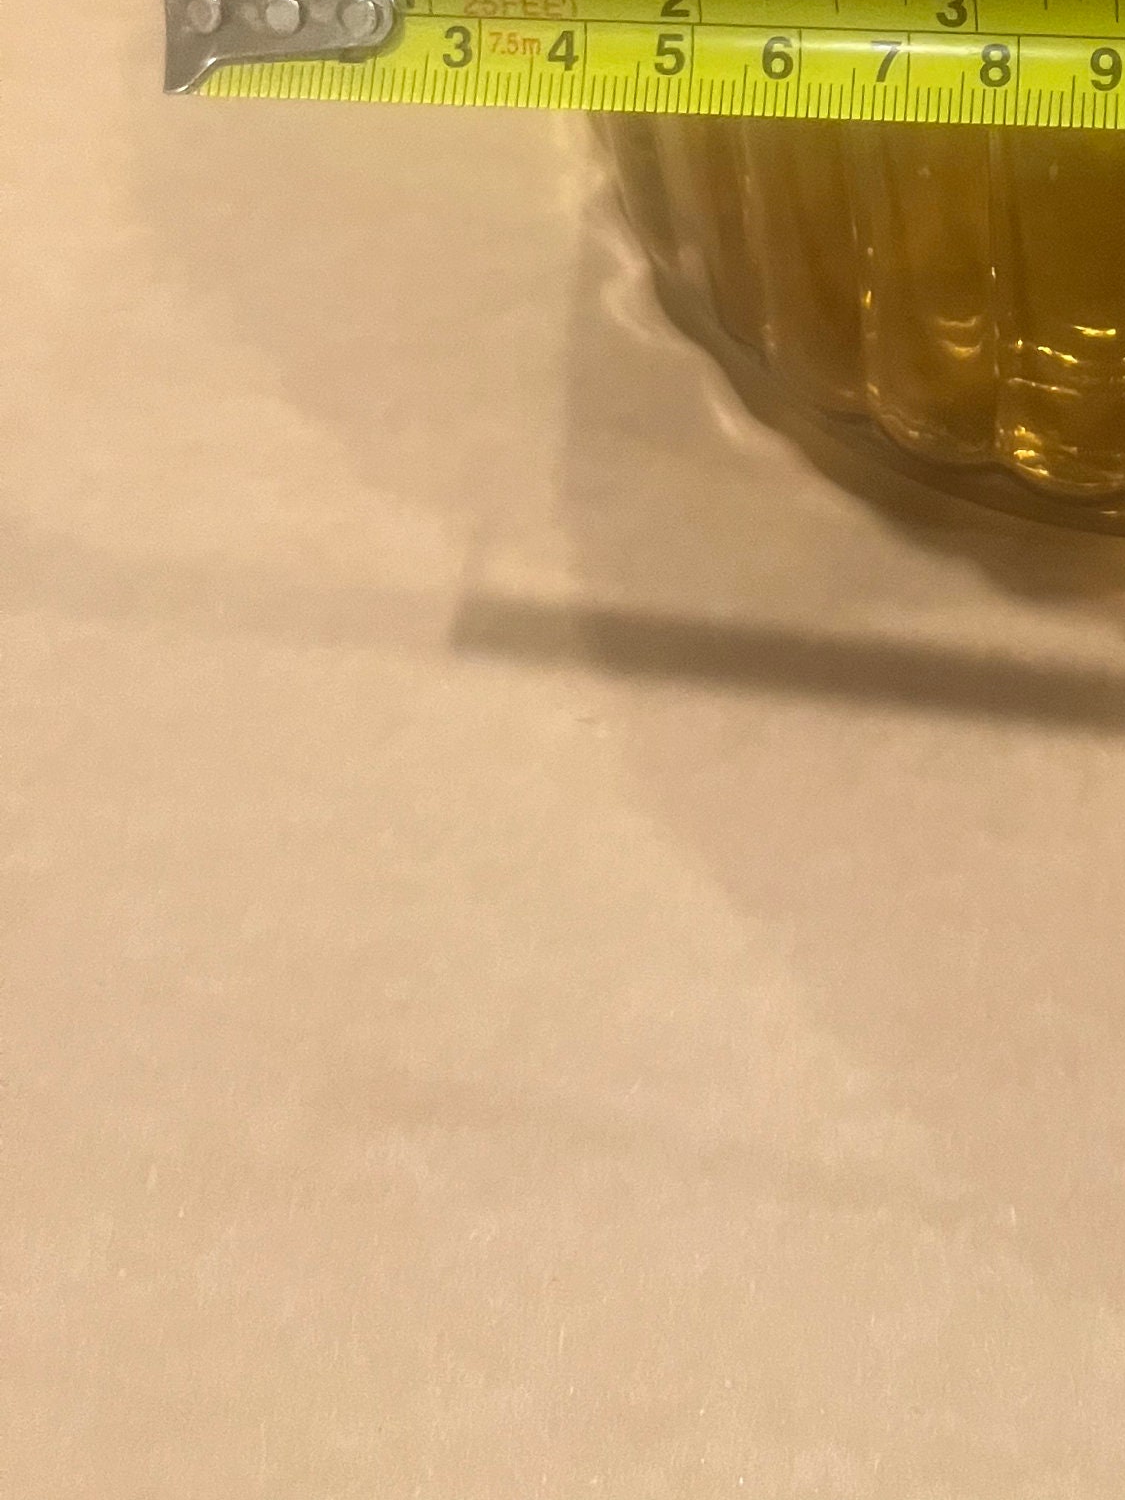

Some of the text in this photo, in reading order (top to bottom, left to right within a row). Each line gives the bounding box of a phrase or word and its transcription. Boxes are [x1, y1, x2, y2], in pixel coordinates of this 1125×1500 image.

[442, 25, 473, 68] 3
[488, 32, 542, 56] 7.5m
[547, 30, 579, 71] 4
[655, 33, 686, 76] 5
[761, 36, 794, 79] 6
[870, 40, 902, 82] 7
[979, 43, 1011, 87] 8
[1090, 47, 1123, 91] 9
